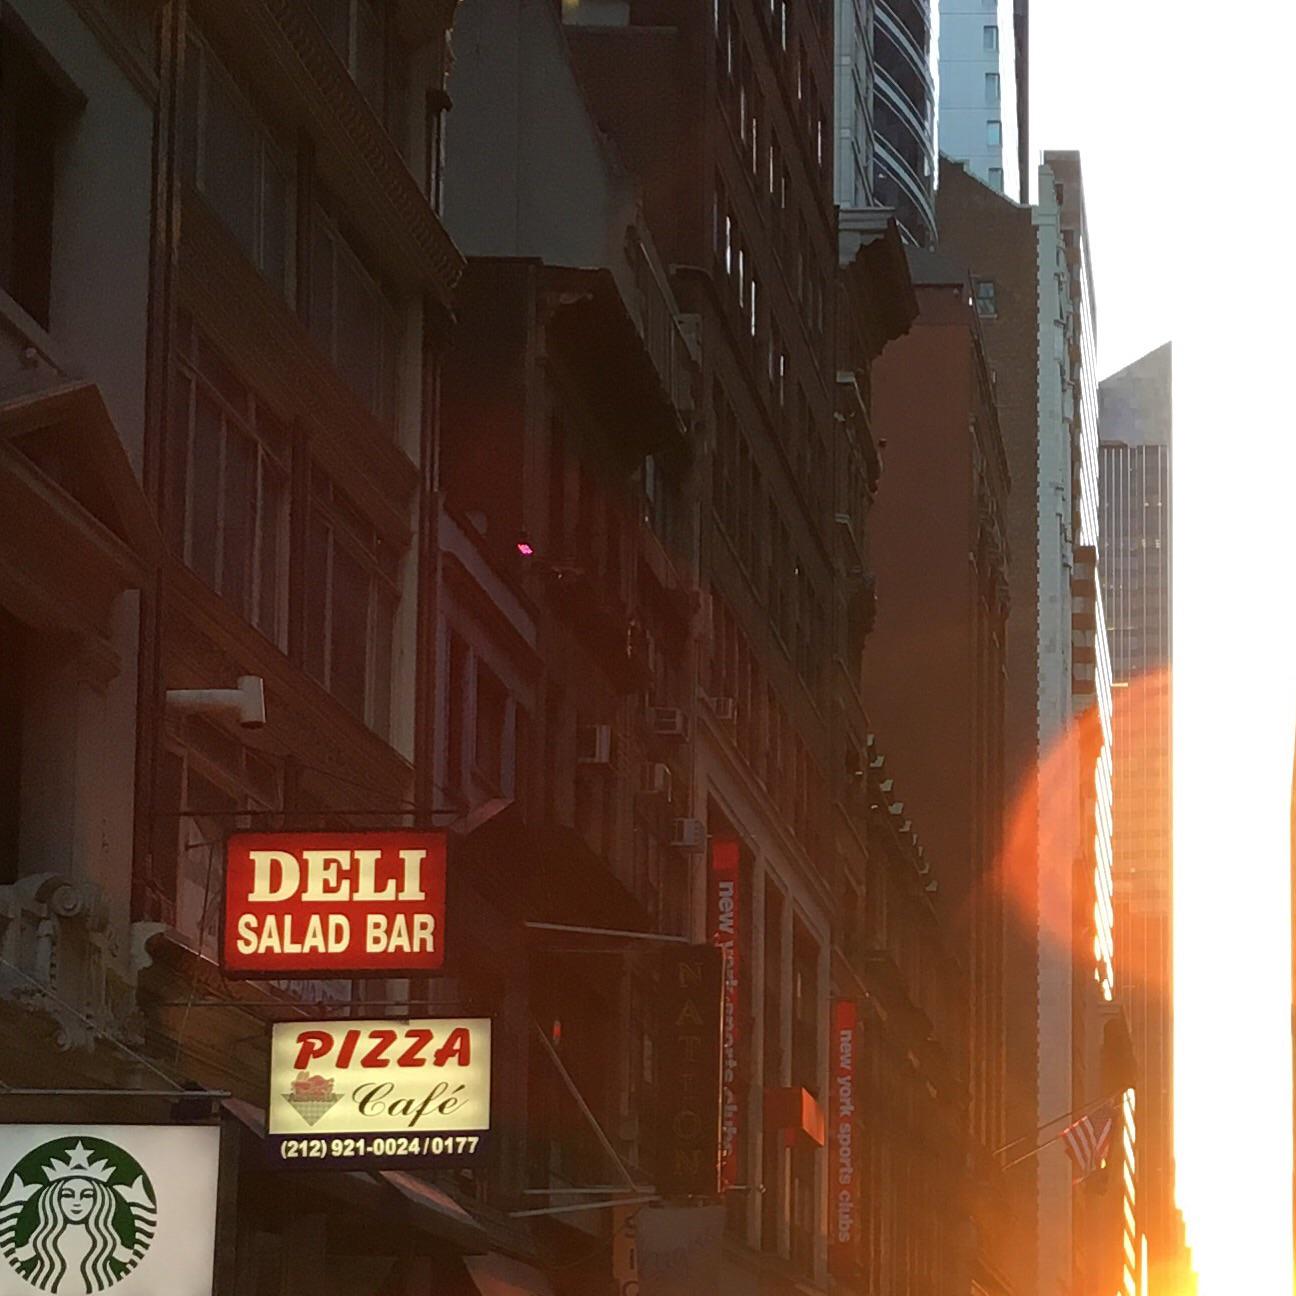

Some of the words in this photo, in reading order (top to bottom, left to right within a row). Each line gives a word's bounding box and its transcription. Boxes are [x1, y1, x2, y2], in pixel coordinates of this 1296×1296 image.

[248, 849, 426, 902] DELI
[719, 881, 734, 933] new
[237, 913, 351, 954] SALAD
[366, 914, 435, 953] BAR
[294, 1027, 471, 1070] PIZZA
[840, 1029, 853, 1070] new
[351, 1082, 470, 1127] Café
[836, 1074, 853, 1116] york
[281, 1140, 328, 1159] (212)
[836, 1123, 853, 1185] sports
[838, 1190, 851, 1243] clubs
